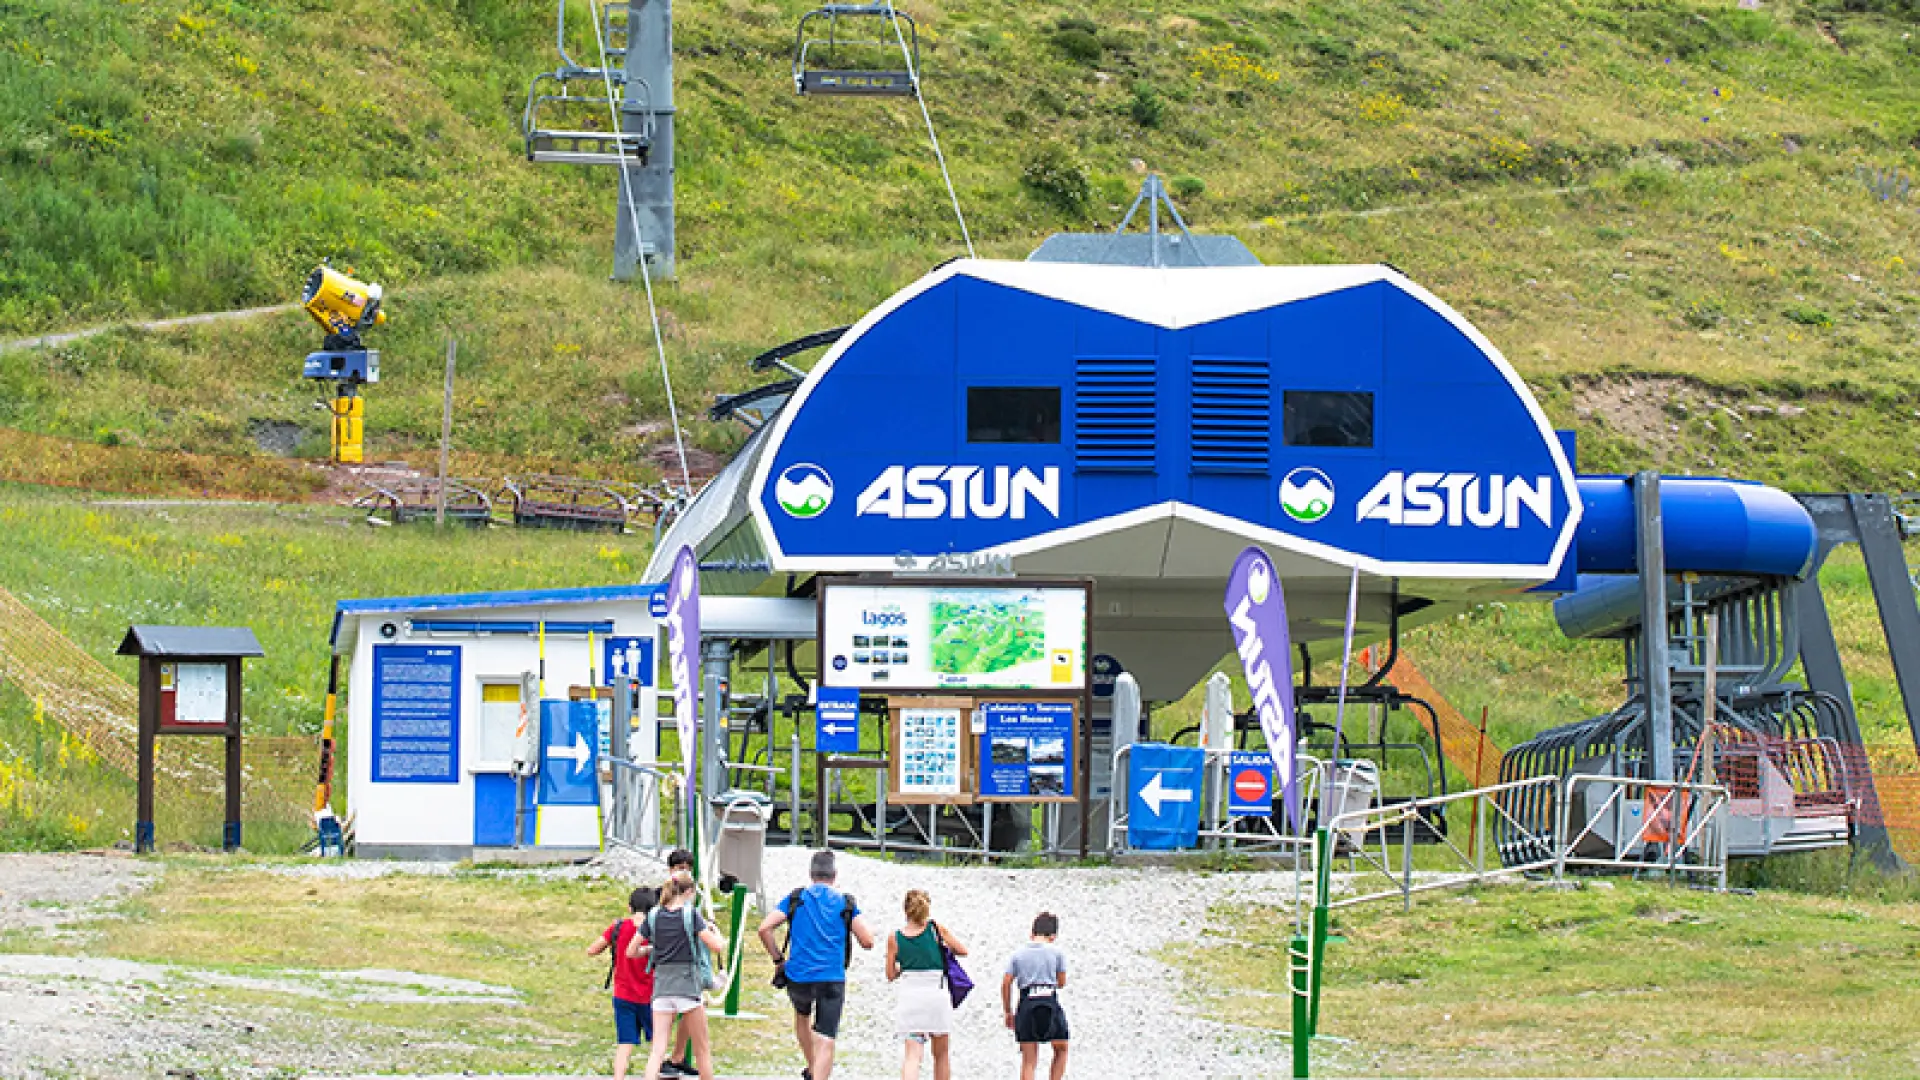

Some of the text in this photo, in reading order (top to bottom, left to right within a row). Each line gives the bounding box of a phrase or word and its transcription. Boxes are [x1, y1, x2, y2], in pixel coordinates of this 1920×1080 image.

[856, 465, 1059, 519] ASTUN
[1356, 471, 1551, 528] ASTUN
[928, 552, 1012, 574] ASTUN
